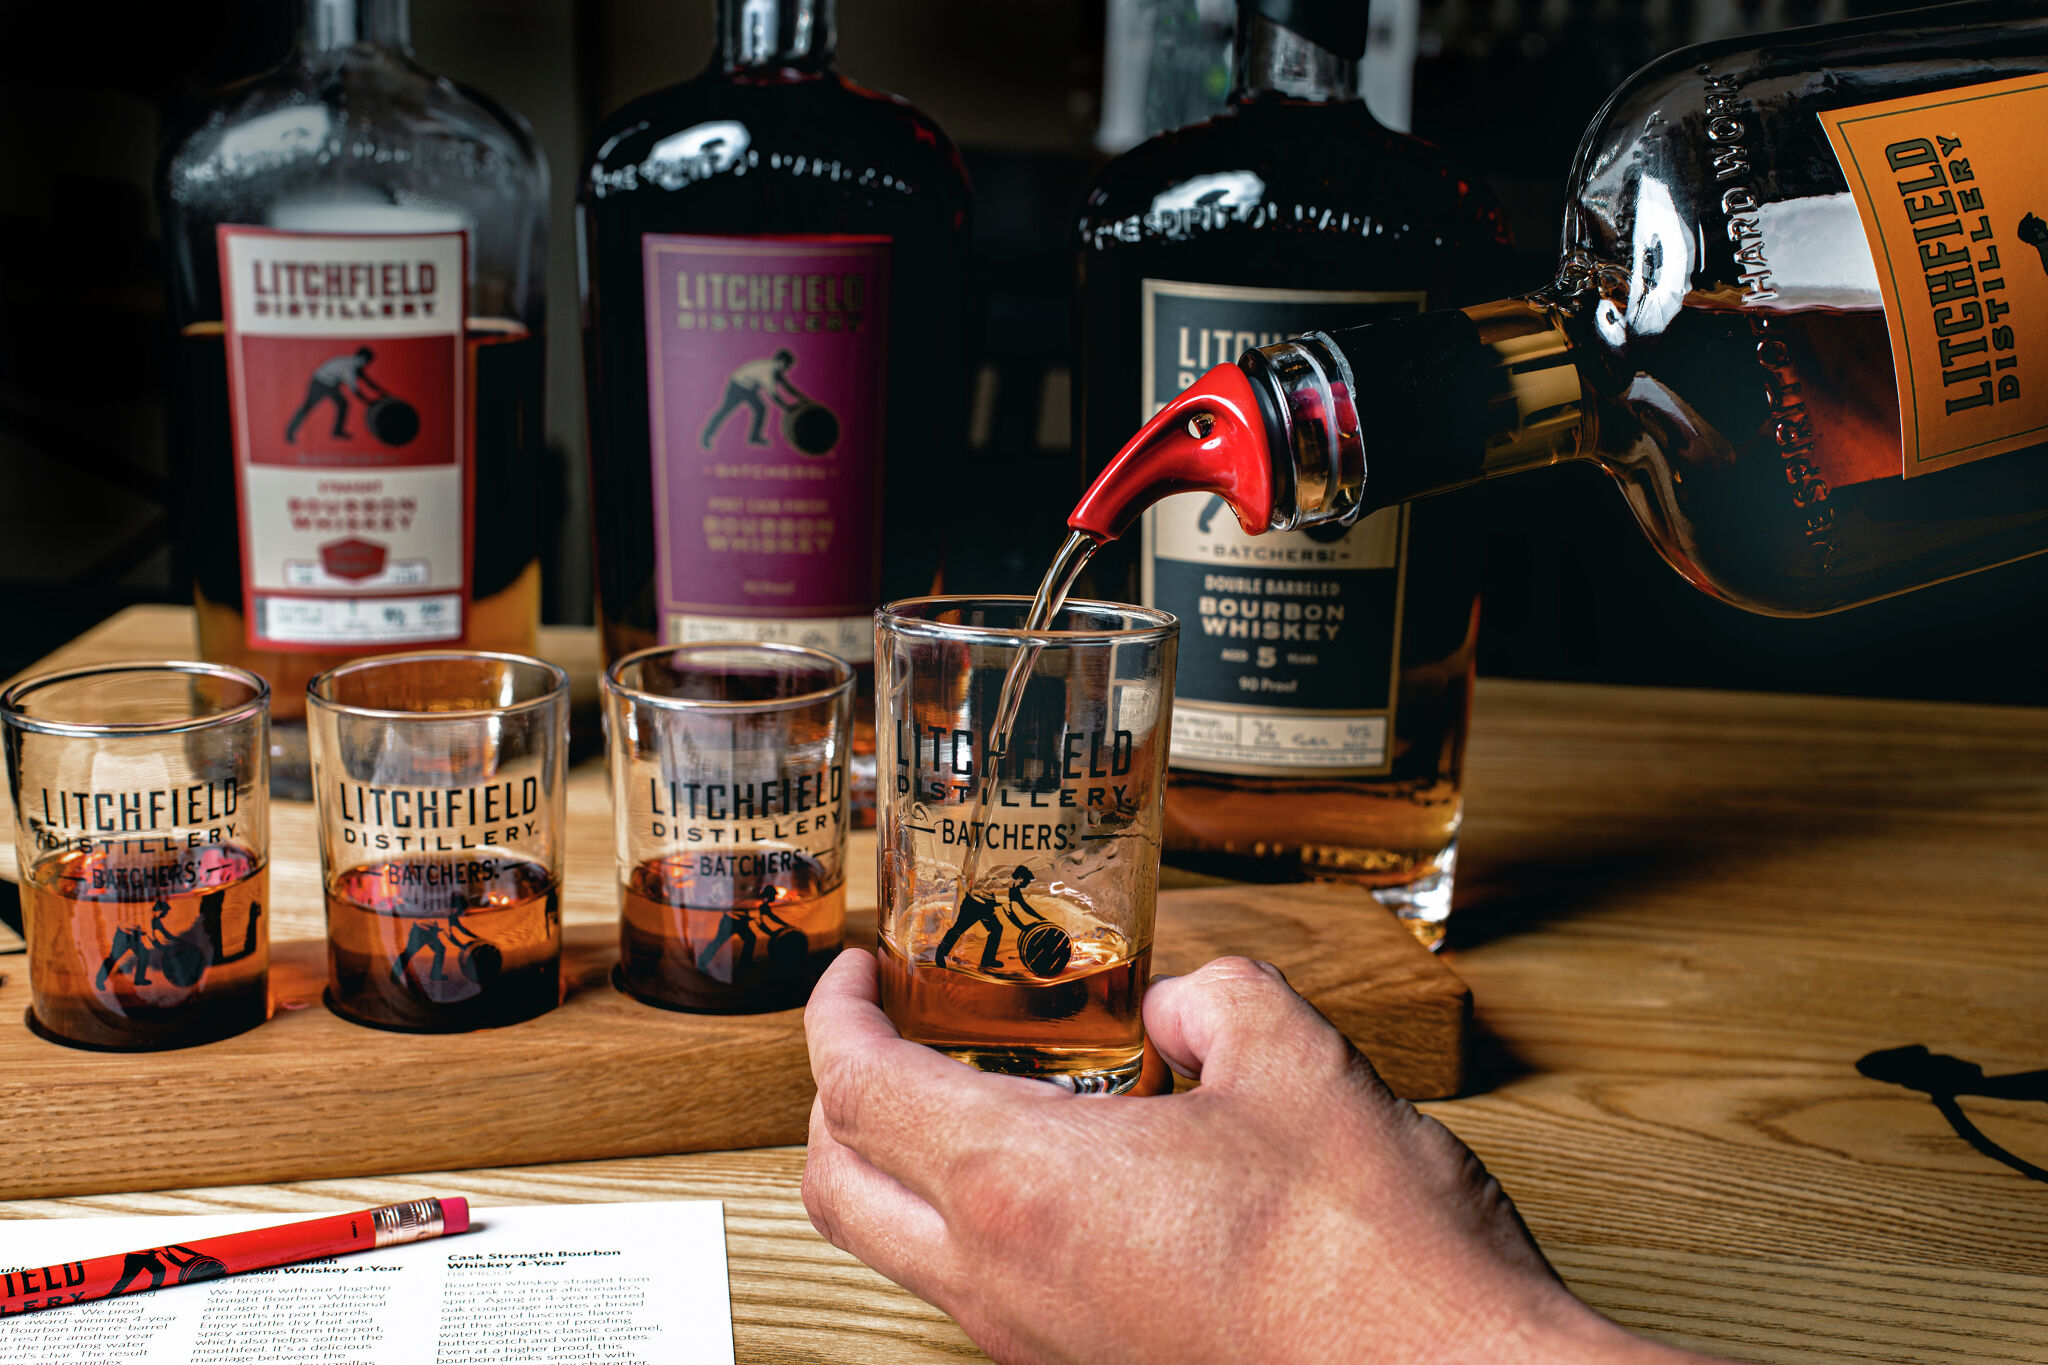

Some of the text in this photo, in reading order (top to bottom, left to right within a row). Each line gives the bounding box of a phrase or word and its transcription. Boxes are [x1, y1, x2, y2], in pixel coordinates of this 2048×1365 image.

[1722, 187, 1779, 304] HARD
[1936, 135, 2021, 403] DISTILLERY
[254, 261, 437, 297] LITCHFIELD
[1885, 138, 1994, 416] LITCHFIELD
[677, 271, 864, 313] LITCHFIELD
[1205, 574, 1340, 597] DOUBLE BARRELED
[1199, 596, 1345, 622] BOURBON
[1202, 616, 1340, 641] WHISKEY
[1256, 646, 1277, 669] 5
[1261, 677, 1298, 693] Proof
[651, 765, 842, 820] LITCHFIELD
[42, 777, 239, 831] LITCHFIELD
[340, 776, 537, 829] LITCHFIELD
[448, 1249, 621, 1261] Cask Strength Bourbon
[283, 1266, 350, 1274] Whiskey
[505, 1279, 559, 1287] whiskey
[564, 1277, 613, 1285] straight
[206, 1296, 259, 1304] Straight
[484, 1296, 525, 1304] Aging
[108, 1307, 145, 1315] proof
[470, 1304, 541, 1312] cooperage
[545, 1302, 589, 1310] invites
[215, 1312, 268, 1320] months
[288, 1311, 316, 1319] port
[440, 1314, 506, 1322] spectrum
[288, 1319, 311, 1327] dry
[496, 1320, 553, 1328] absence
[574, 1317, 632, 1326] proofing
[10, 1326, 69, 1334] Bourbon
[291, 1327, 323, 1335] from
[483, 1328, 550, 1337] highlights
[66, 1333, 121, 1341] another
[195, 1338, 236, 1346] which
[240, 1337, 268, 1345] also
[272, 1336, 309, 1344] helps
[438, 1337, 527, 1346] butterscotch
[42, 1342, 101, 1351] proofing
[310, 1343, 372, 1351] delicious
[505, 1346, 548, 1354] higher
[80, 1349, 148, 1358] The result
[190, 1355, 254, 1363] marriage
[258, 1353, 319, 1361] between
[436, 1356, 496, 1364] bourbon
[500, 1354, 542, 1362] drinks
[548, 1352, 600, 1360] smooth
